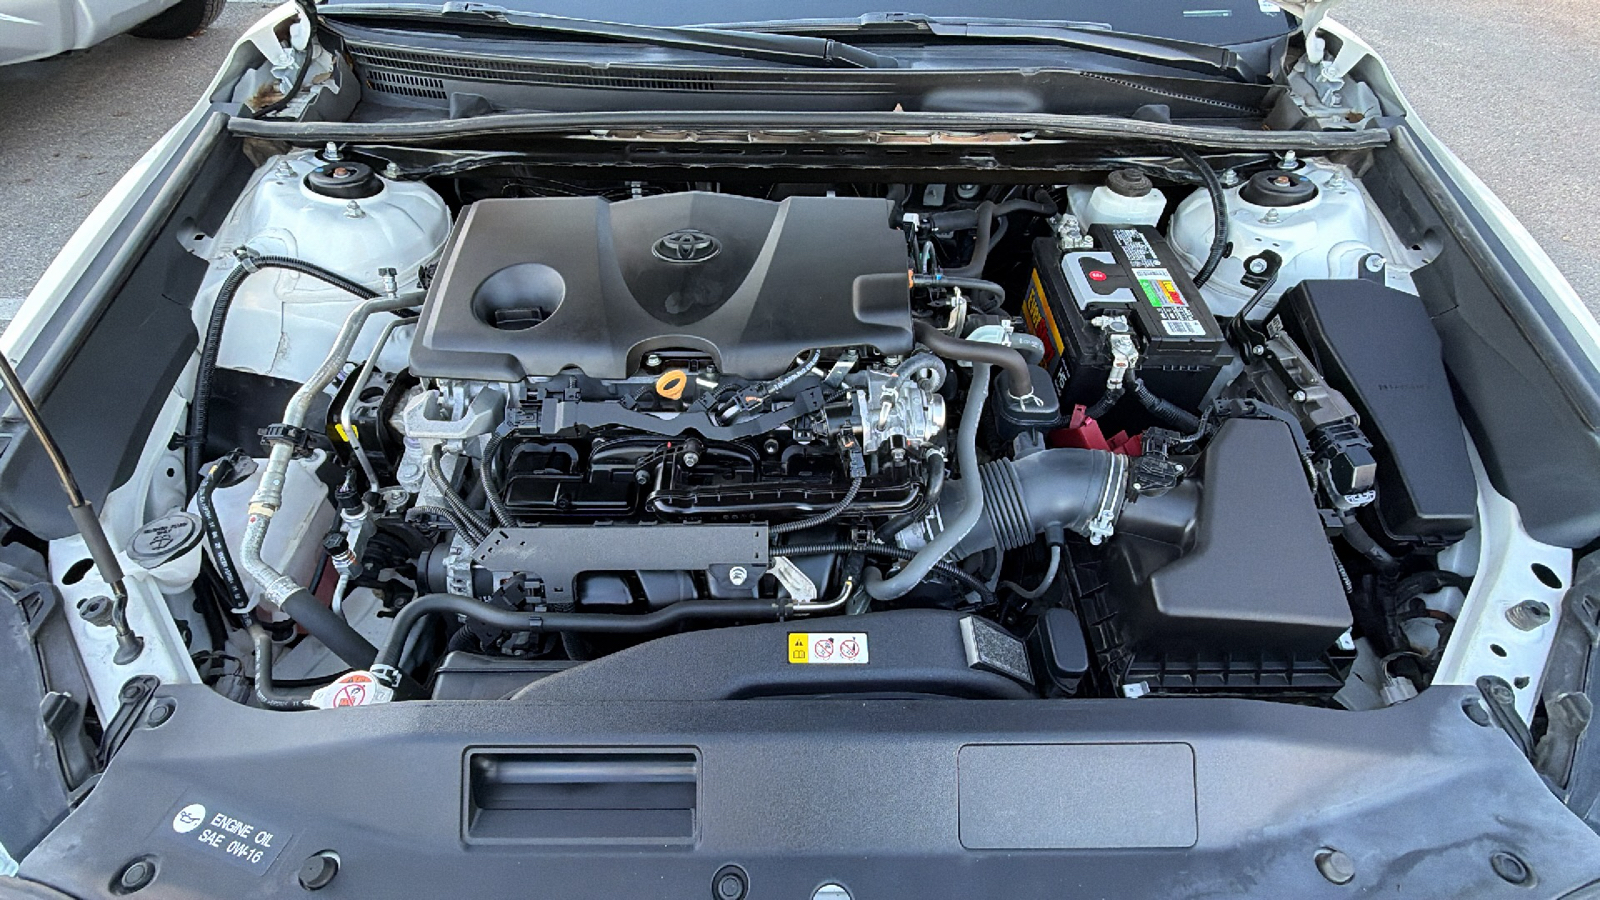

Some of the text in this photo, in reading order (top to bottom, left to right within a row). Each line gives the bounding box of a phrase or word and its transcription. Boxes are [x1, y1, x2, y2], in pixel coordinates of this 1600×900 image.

[198, 829, 264, 864] SAE 0W-16
[210, 812, 274, 848] ENGINE OIL
